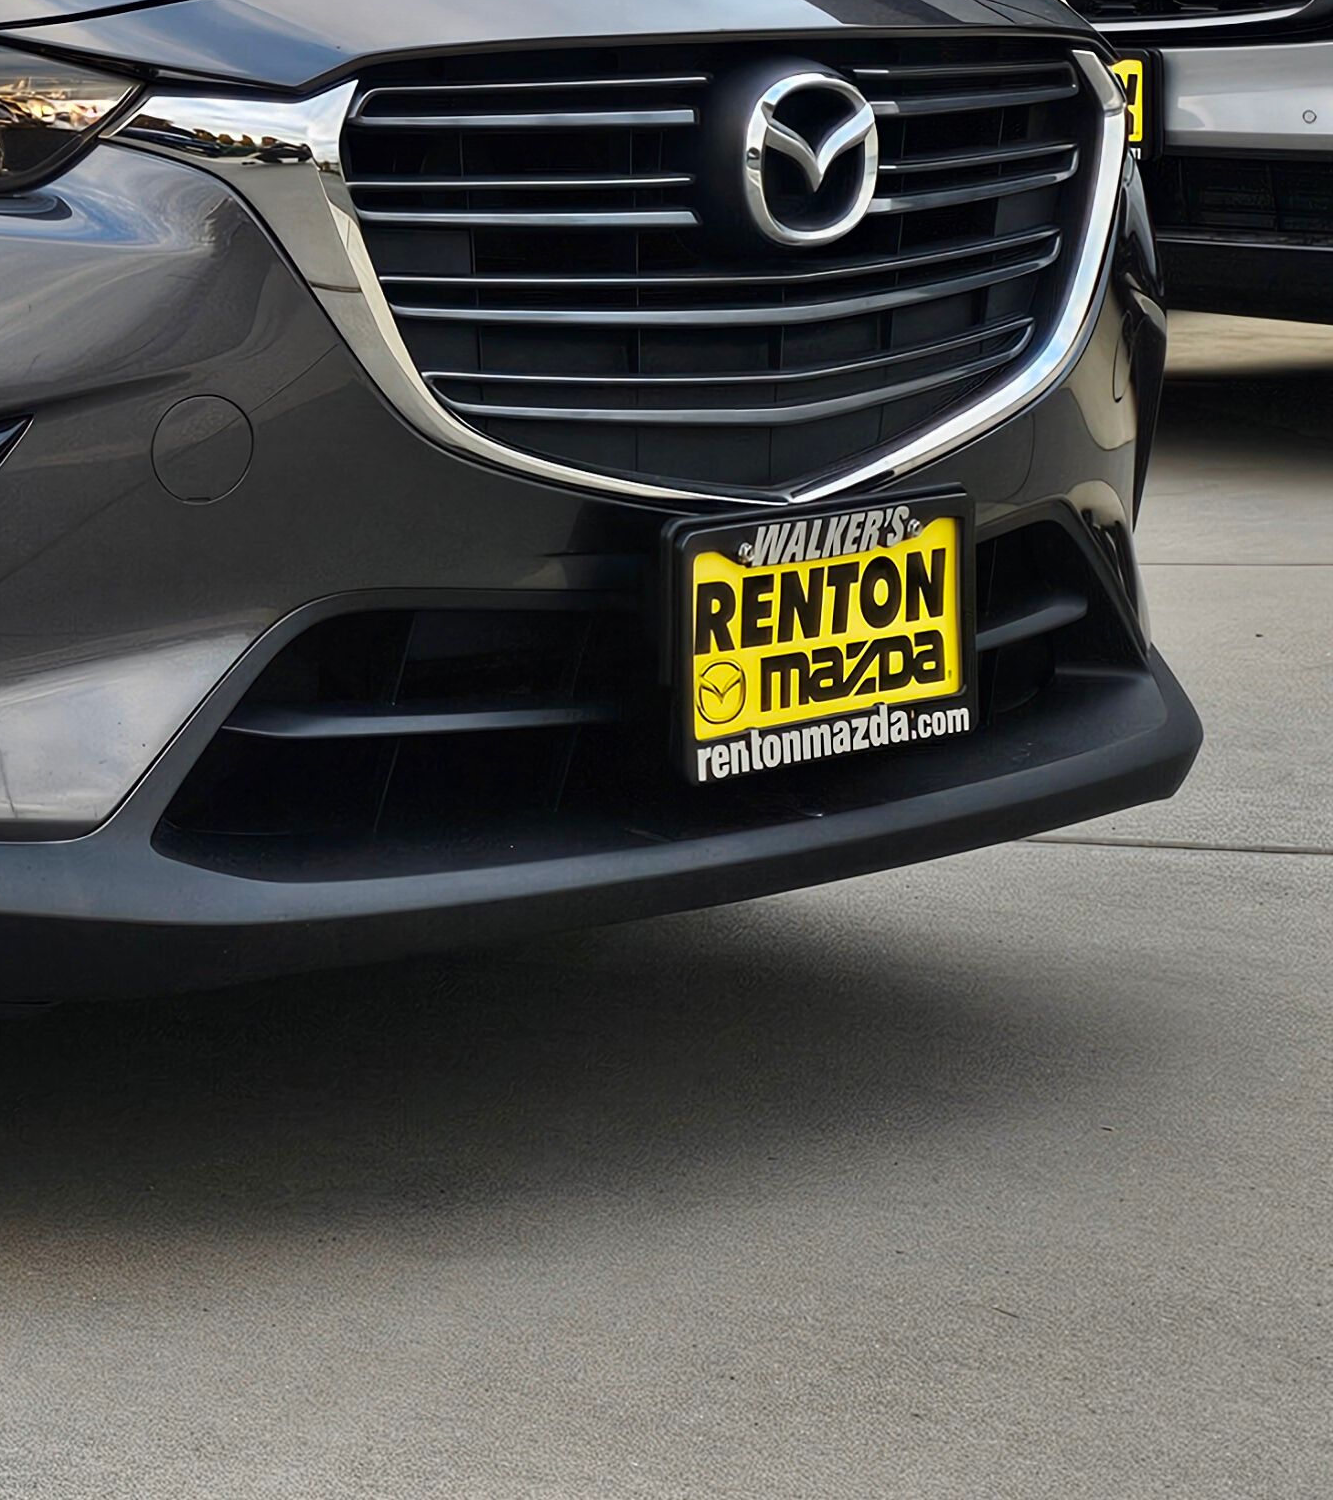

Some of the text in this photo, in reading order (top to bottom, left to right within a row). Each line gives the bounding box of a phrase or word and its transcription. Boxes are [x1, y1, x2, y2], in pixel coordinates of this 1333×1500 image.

[751, 505, 910, 567] WALKER'S
[694, 547, 947, 655] RENTON
[760, 629, 946, 713] mazda
[696, 704, 970, 783] rentonmazda.com
